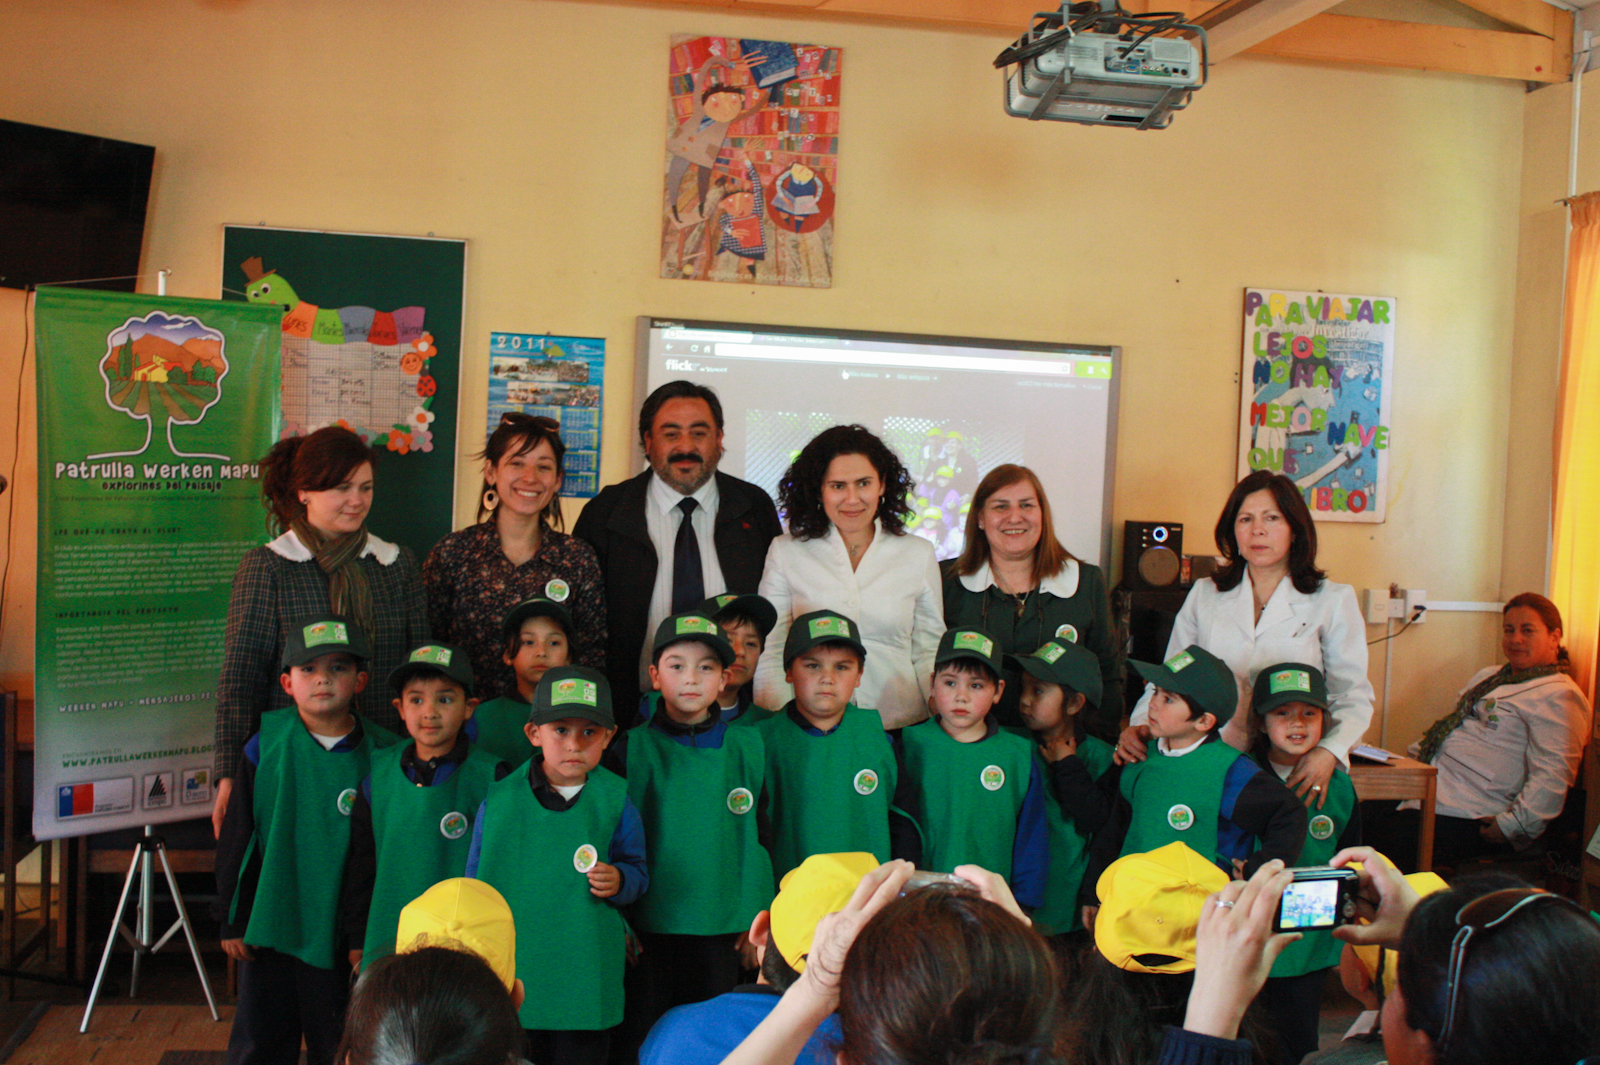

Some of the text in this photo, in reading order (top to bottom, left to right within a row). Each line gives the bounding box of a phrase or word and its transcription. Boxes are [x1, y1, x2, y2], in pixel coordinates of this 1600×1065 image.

[1245, 291, 1390, 327] PARA VIAJAR
[497, 336, 545, 350] 2011
[1253, 331, 1327, 359] LEJOS
[665, 359, 700, 371] flickr
[1253, 360, 1344, 389] NO HAY
[1250, 402, 1389, 450] MEJOR NAVE
[55, 462, 135, 479] Patrulla
[143, 461, 213, 479] Werken
[1248, 447, 1298, 475] QUE
[59, 703, 96, 712] WERKEN
[101, 700, 124, 709] MAPU
[138, 693, 196, 706] MENSAJEROS
